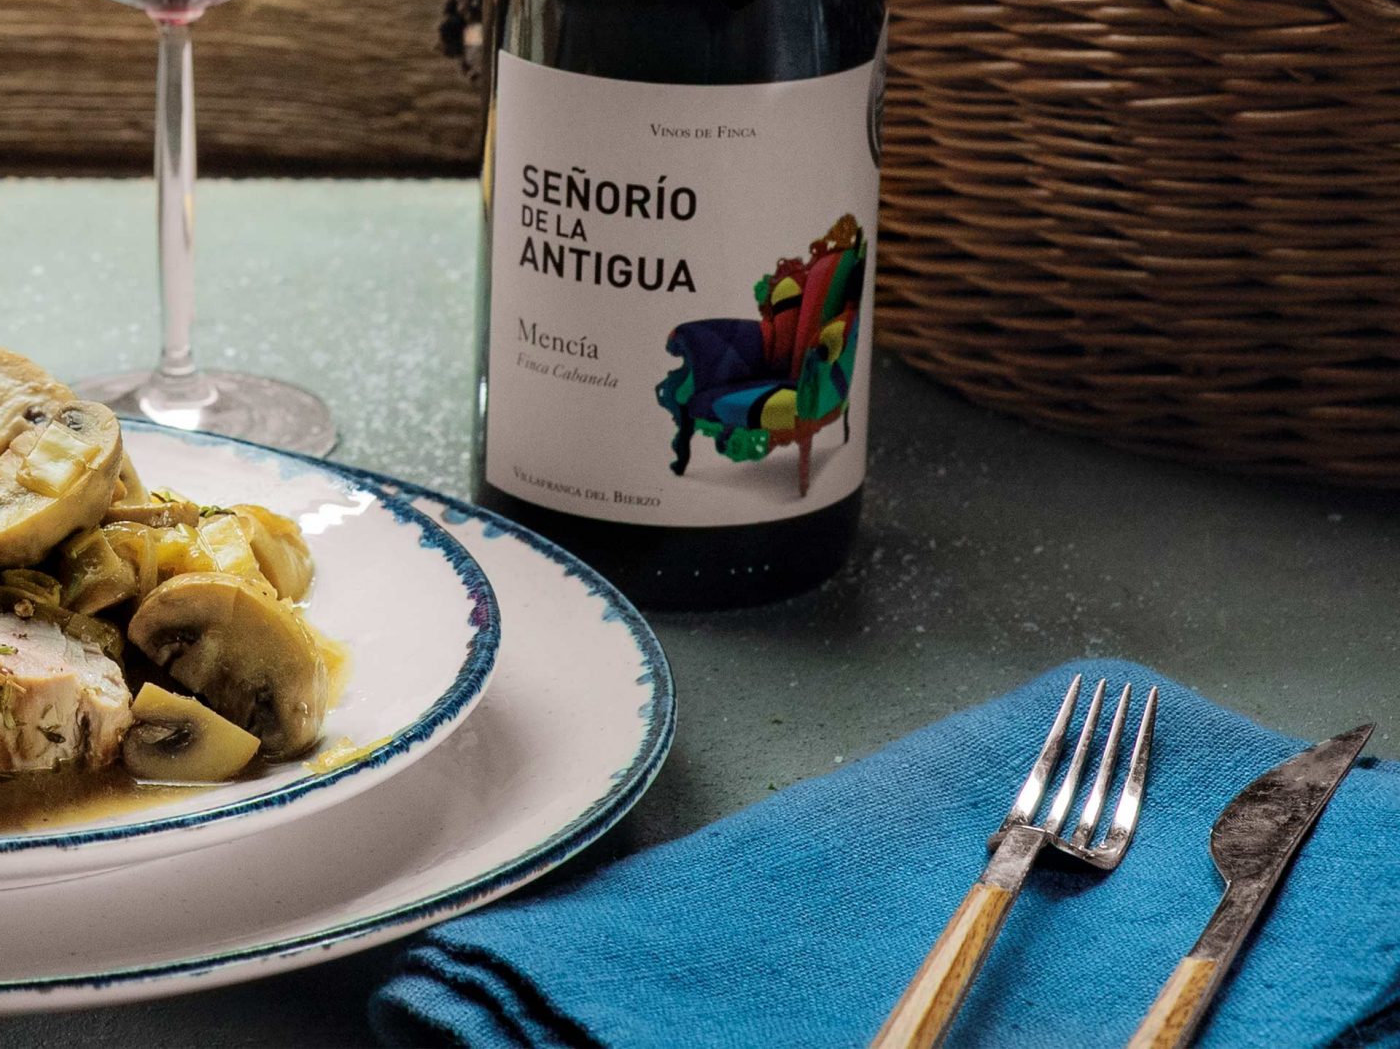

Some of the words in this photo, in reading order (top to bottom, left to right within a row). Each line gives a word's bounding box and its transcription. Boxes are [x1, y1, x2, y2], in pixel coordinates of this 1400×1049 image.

[650, 123, 690, 138] VINOS
[695, 128, 712, 139] DE
[717, 125, 756, 138] FINCA
[522, 164, 697, 221] SEÑORÍO
[521, 204, 548, 233] DE
[556, 214, 588, 242] LA
[519, 236, 697, 293] ANTIGUA
[518, 317, 598, 360] Mencía
[517, 352, 550, 374] Finca
[585, 488, 608, 502] DEL
[613, 490, 661, 507] BIERZO
